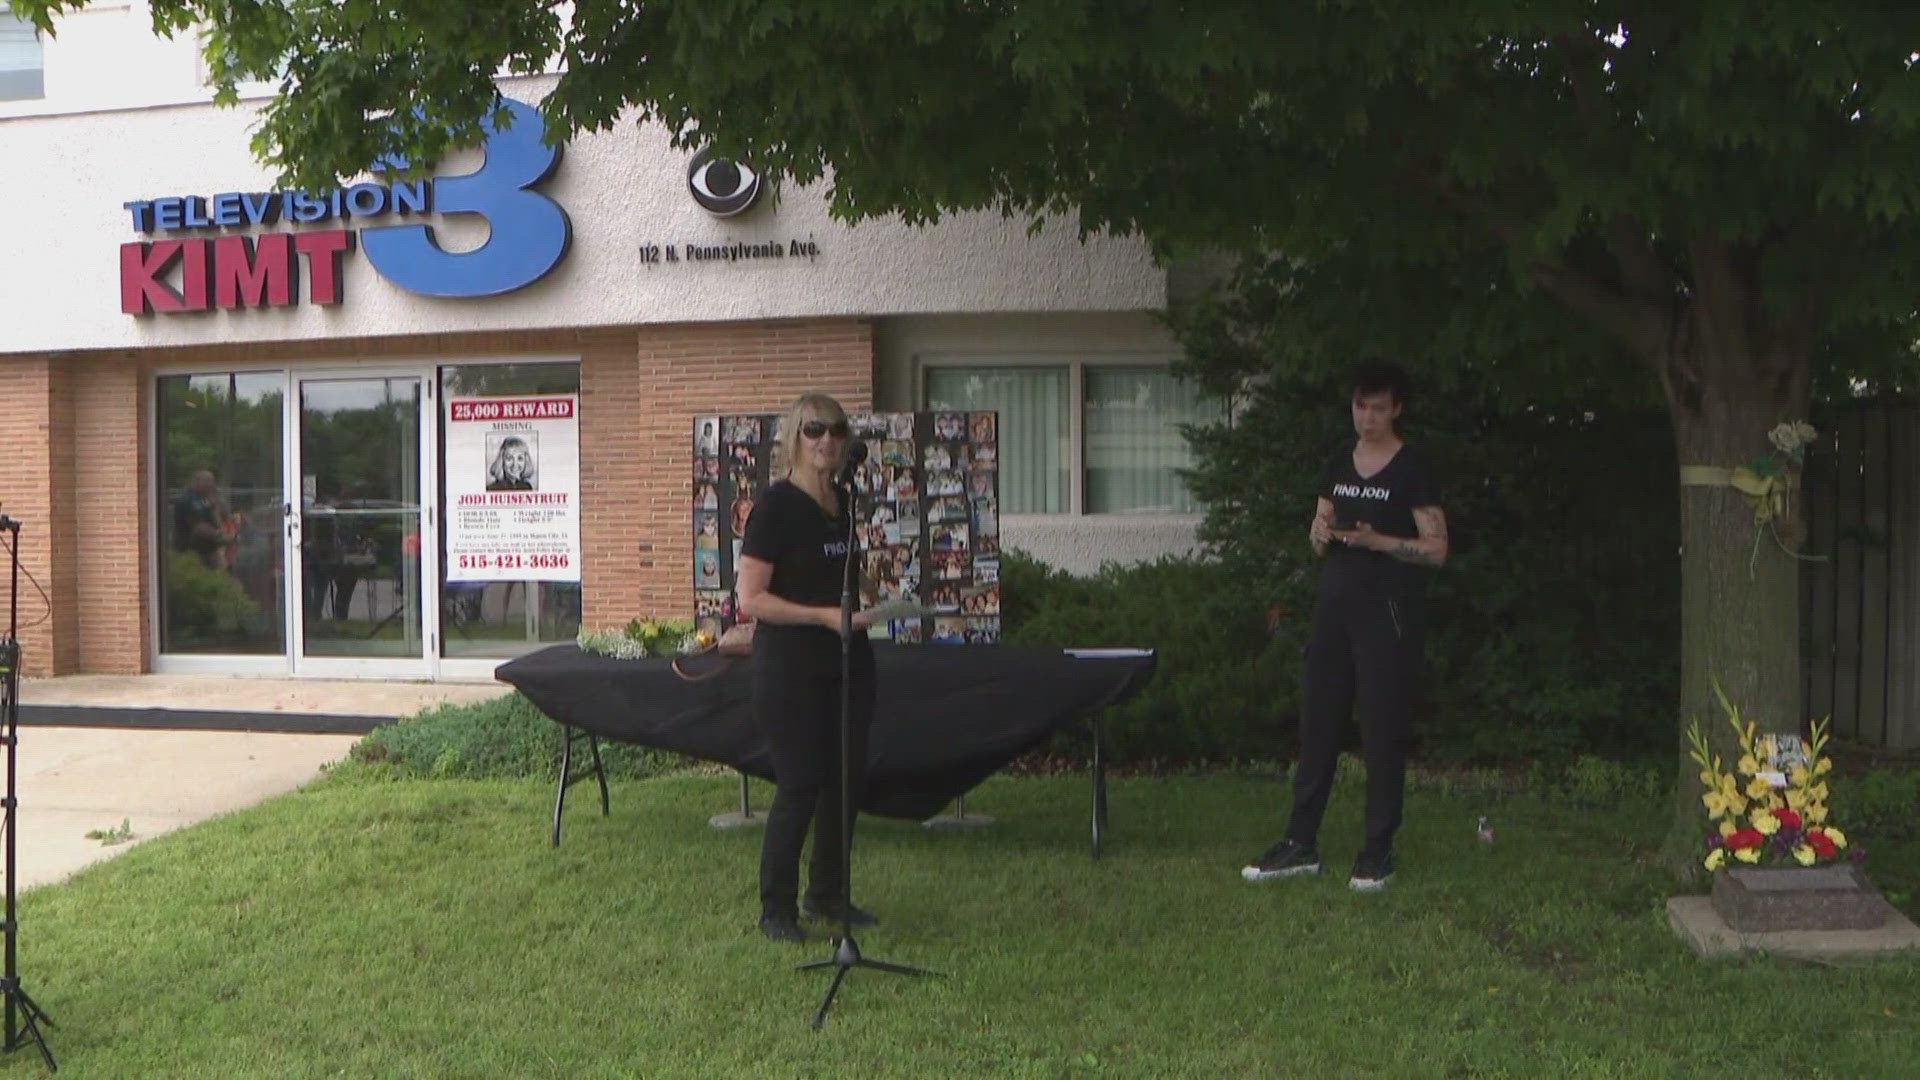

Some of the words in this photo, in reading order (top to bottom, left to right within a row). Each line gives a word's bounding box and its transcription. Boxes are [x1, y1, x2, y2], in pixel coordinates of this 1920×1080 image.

[124, 179, 427, 232] TELEVISION
[360, 97, 570, 297] 3
[639, 244, 659, 263] 112
[666, 244, 679, 262] N.
[686, 240, 783, 262] Pennsylvania
[789, 239, 820, 258] Ave.
[120, 230, 350, 313] KIMT
[455, 403, 499, 421] 25,000
[502, 401, 570, 417] REWARD
[491, 422, 532, 430] MISSING
[458, 494, 486, 505] JODI
[490, 493, 568, 504] HUISENTRUIT
[1333, 484, 1360, 497] FIND
[1360, 486, 1390, 501] JODI
[459, 554, 569, 568] 515-421-3636
